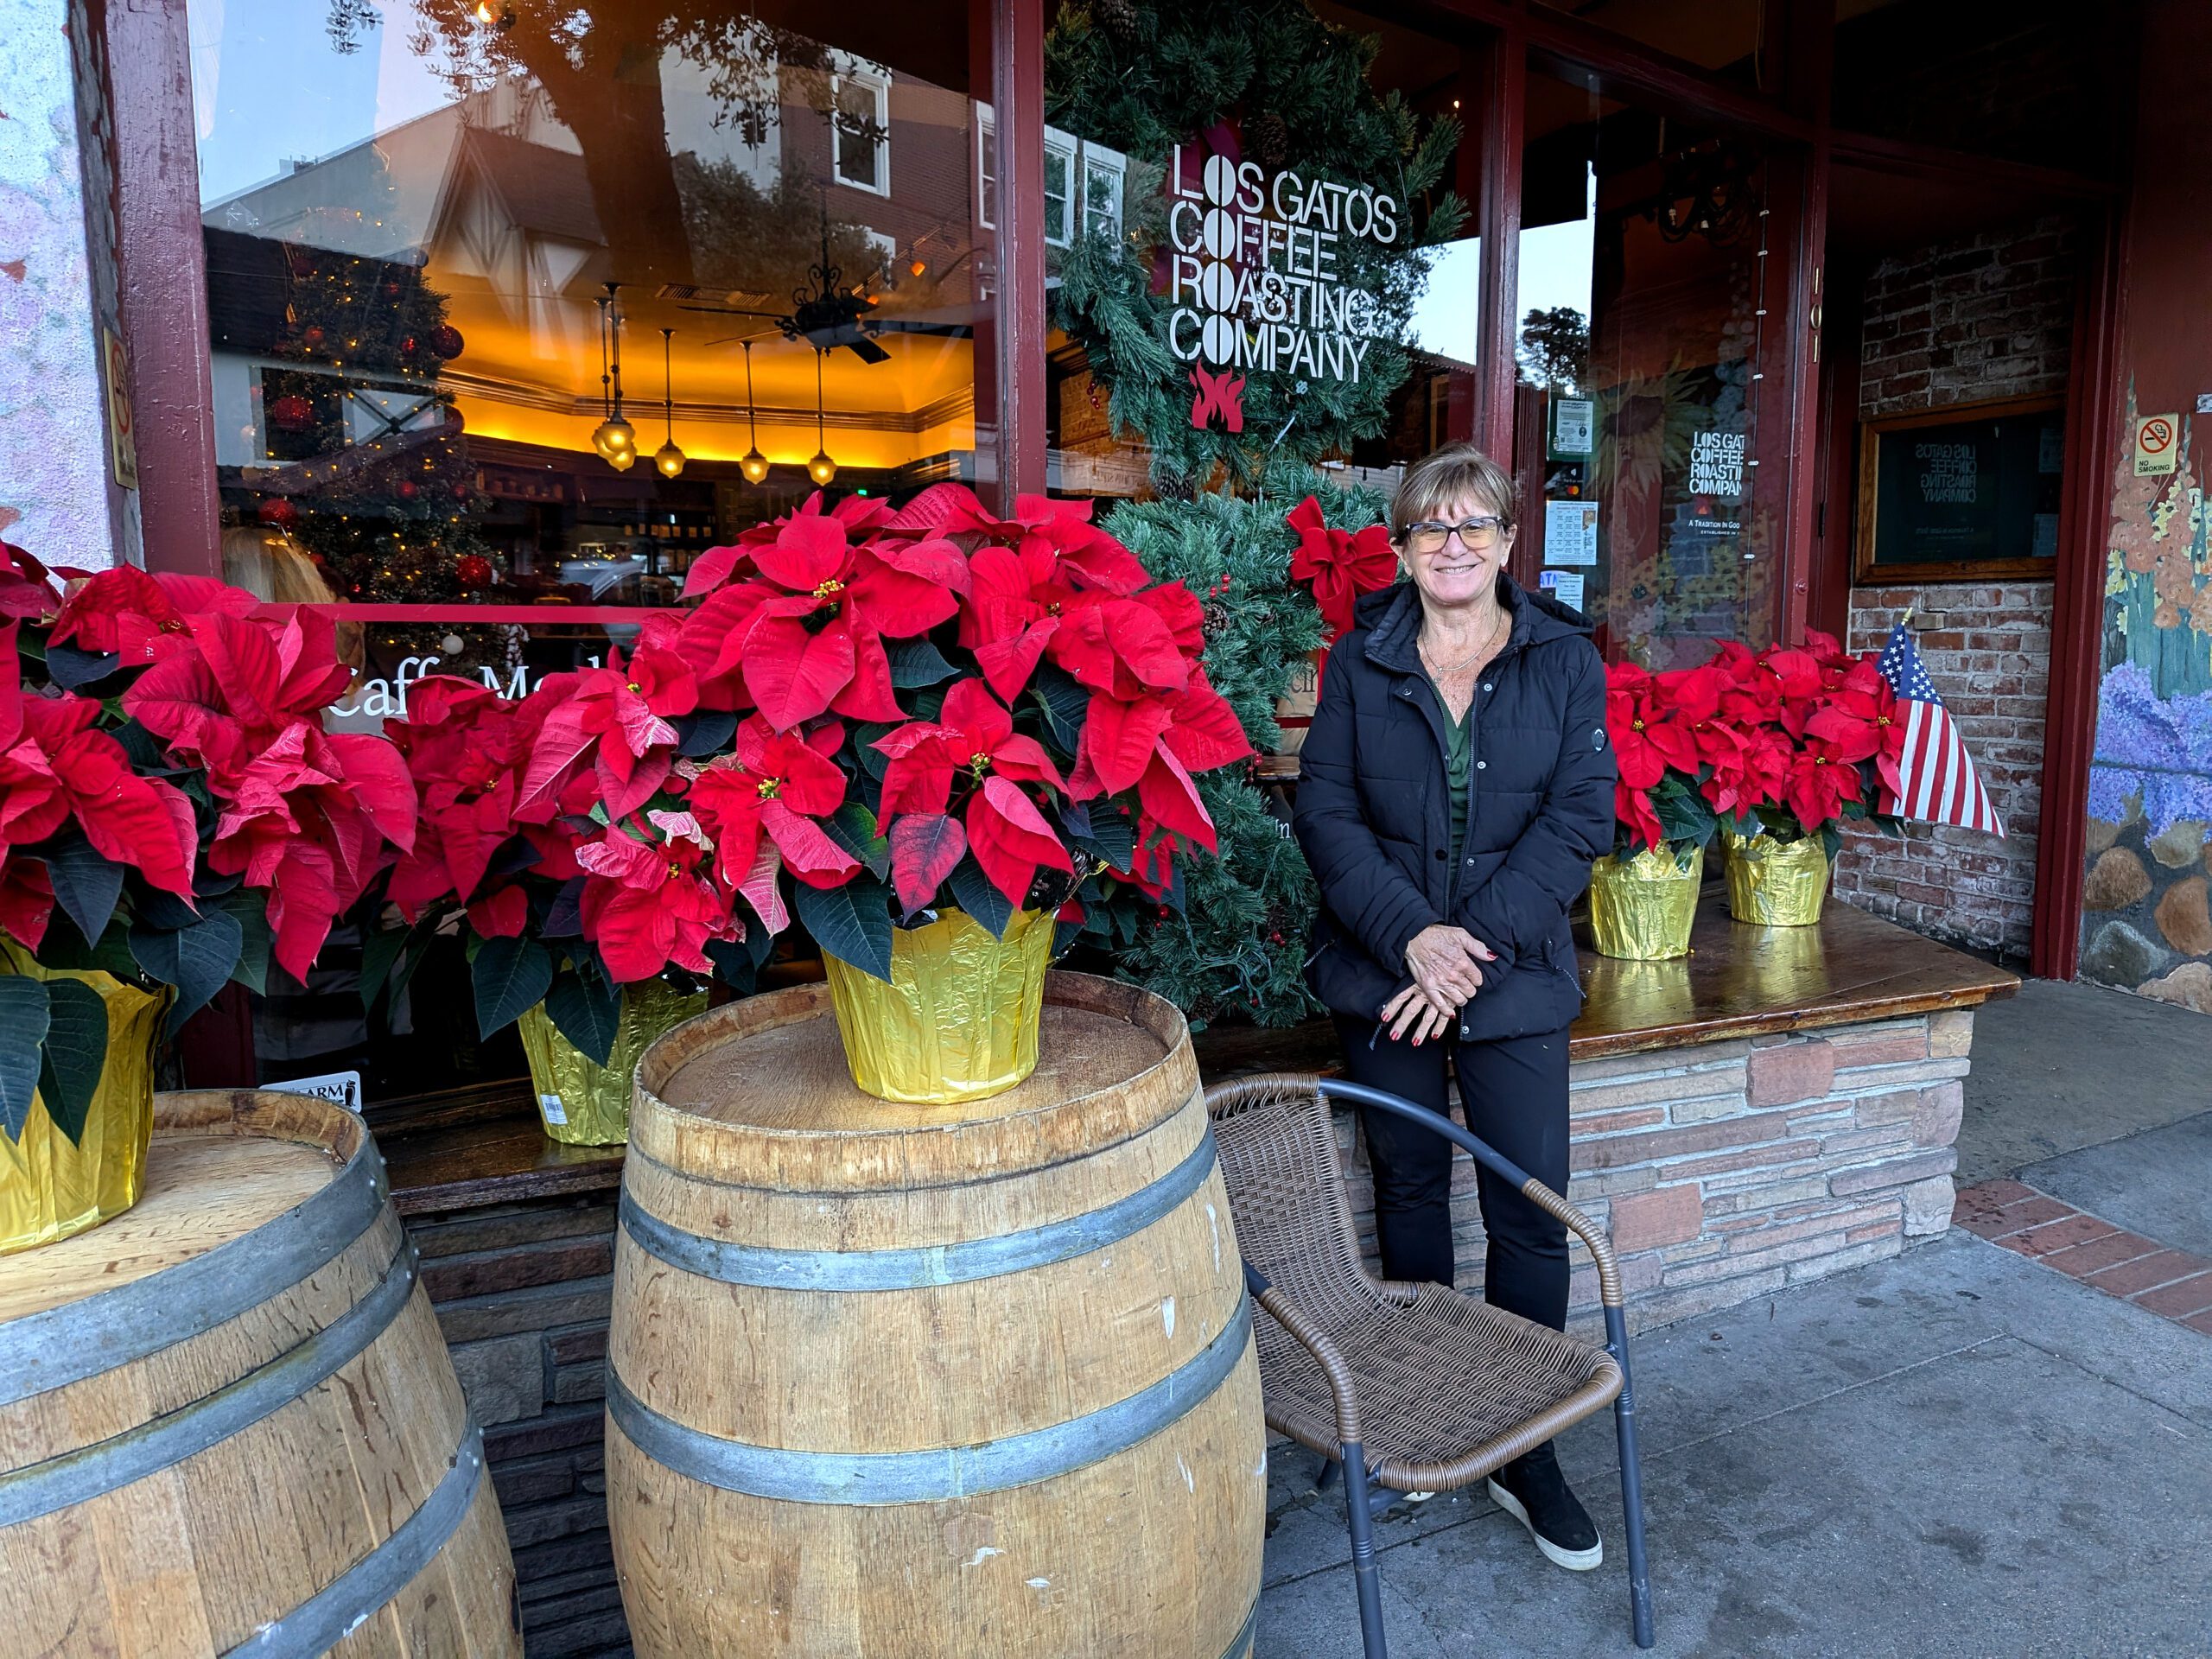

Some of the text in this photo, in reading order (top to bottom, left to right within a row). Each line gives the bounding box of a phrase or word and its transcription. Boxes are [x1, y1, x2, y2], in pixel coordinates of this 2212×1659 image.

[1173, 144, 1397, 244] LOS GATOS
[1170, 200, 1338, 282] COFFEE
[1172, 253, 1374, 337] ROASTING
[1170, 308, 1370, 384] COMPANY
[1694, 431, 1720, 448] LOS
